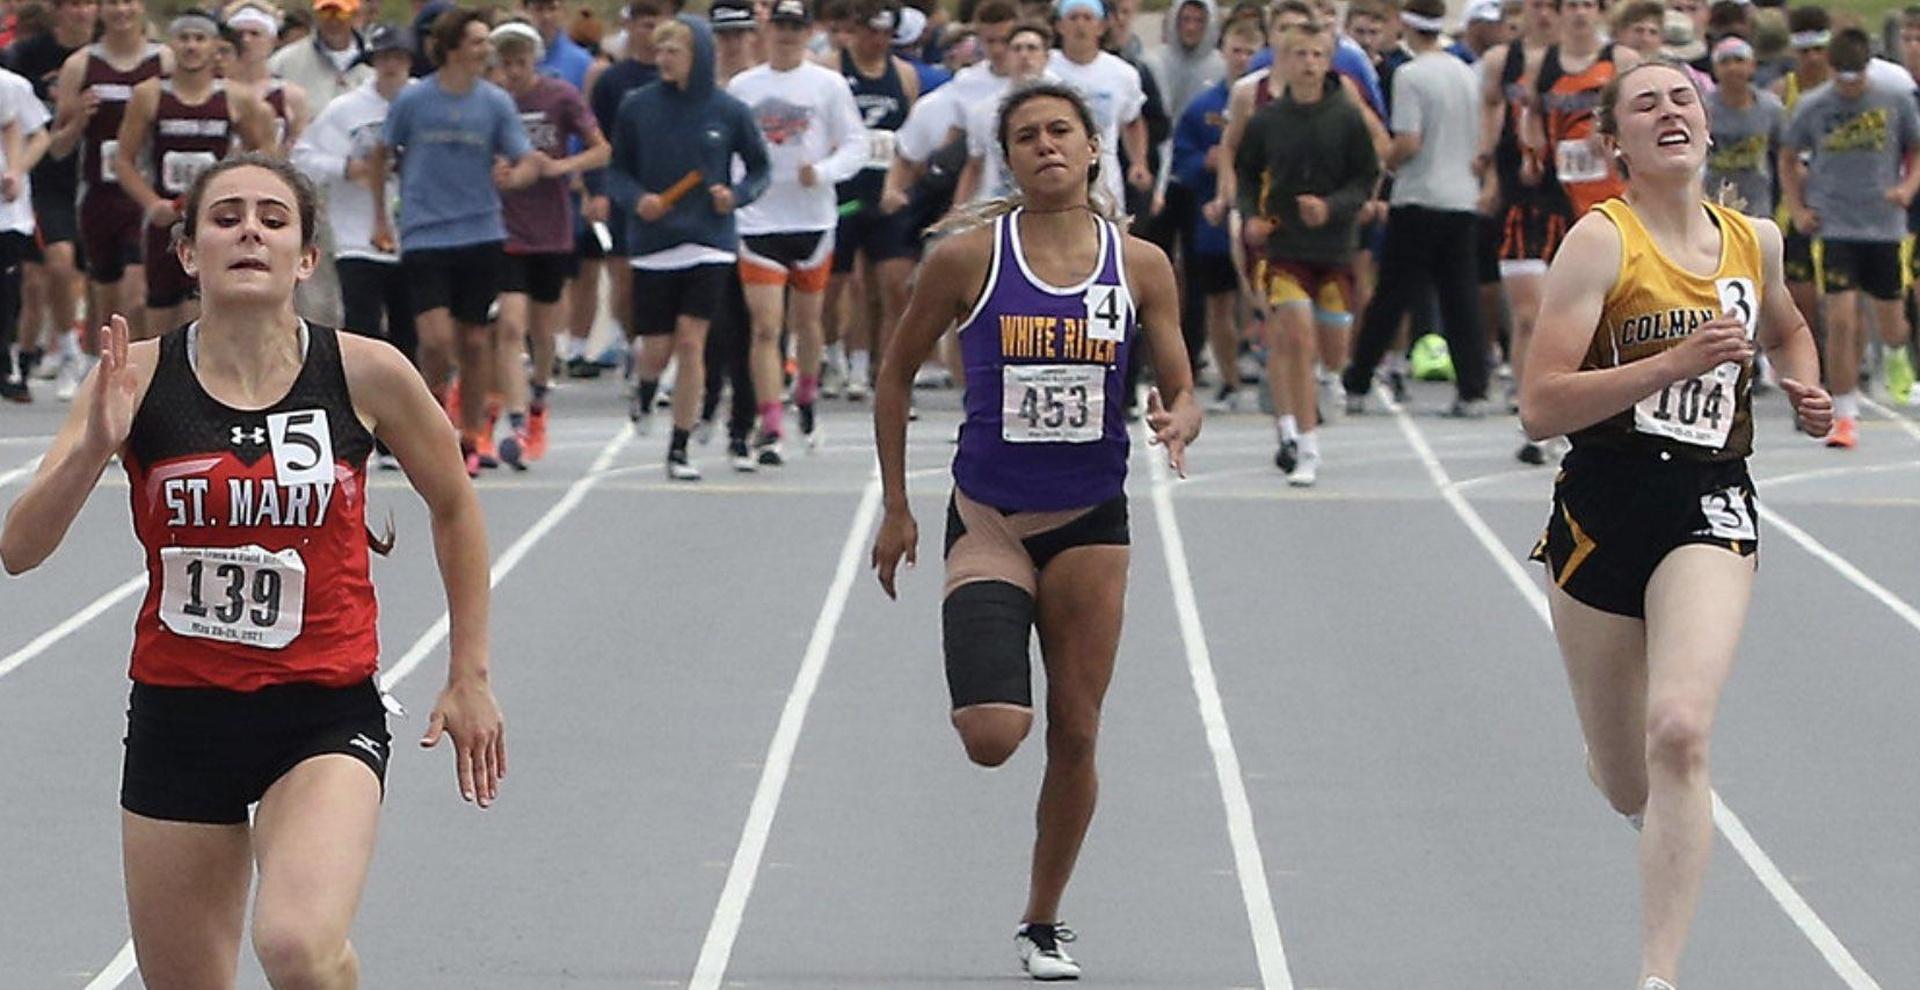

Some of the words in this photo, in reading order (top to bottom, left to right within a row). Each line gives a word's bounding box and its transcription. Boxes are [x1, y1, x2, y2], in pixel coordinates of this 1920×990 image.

[1094, 287, 1120, 331] 4
[1726, 280, 1751, 325] 3
[999, 315, 1058, 359] WHITE
[1017, 384, 1089, 429] 453
[1652, 377, 1724, 430] 104
[284, 413, 322, 471] 5
[165, 480, 217, 527] ST.
[228, 479, 335, 527] MARY
[1709, 490, 1743, 529] 3
[183, 558, 282, 628] 139
